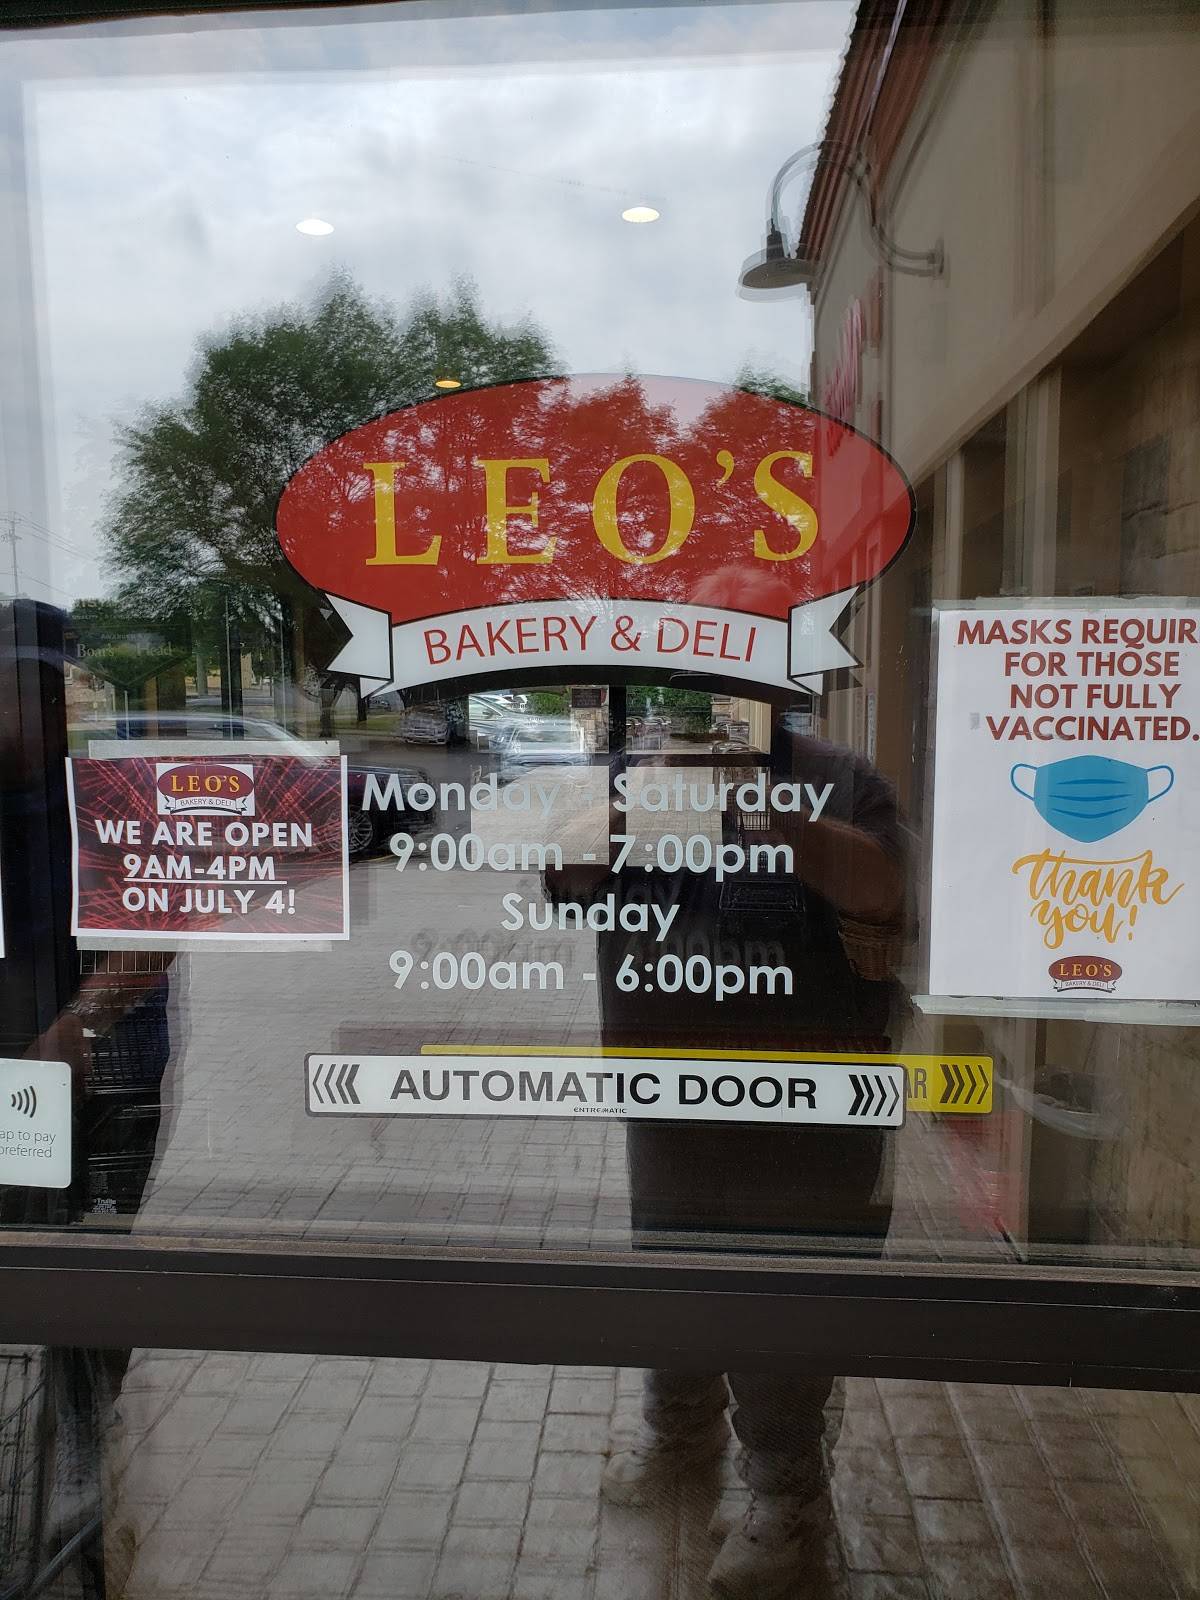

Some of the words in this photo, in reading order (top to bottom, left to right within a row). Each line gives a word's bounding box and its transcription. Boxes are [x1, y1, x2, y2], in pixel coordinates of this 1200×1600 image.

[363, 450, 819, 566] LEO'S
[423, 615, 597, 665] BAKERY
[611, 616, 641, 652] &
[656, 618, 757, 663] DELI
[957, 619, 1072, 645] MASKS
[1082, 618, 1199, 649] REQUIR
[1004, 651, 1068, 677] FOR
[1076, 651, 1180, 677] THOSE
[1010, 683, 1078, 709] NOT
[1086, 683, 1181, 709] FULLY
[985, 715, 1199, 741] VACCINATED.
[171, 775, 240, 793] LEO'S
[361, 772, 562, 818] Monday
[612, 772, 835, 823] Saturday
[180, 797, 207, 806] BAKERY
[95, 819, 142, 845] WE
[151, 821, 213, 846] ARE
[224, 821, 313, 847] OPEN
[123, 853, 276, 880] 9AM-4PM
[389, 832, 563, 873] 9:00am
[609, 834, 794, 883] 7:00pm
[1011, 847, 1185, 909] thank
[122, 886, 169, 913] ON
[179, 888, 256, 914] JULY
[264, 888, 296, 915] 4!
[501, 892, 681, 942] Sunday
[1030, 899, 1138, 949] you!
[389, 950, 564, 990] 9:00am
[615, 953, 793, 1001] 6:00pm
[1059, 963, 1113, 977] LEO'S
[389, 1069, 662, 1105] AUTOMATIC
[677, 1074, 818, 1109] DOOR
[0, 1130, 15, 1142] ap
[17, 1131, 31, 1141] to
[34, 1132, 57, 1145] pay
